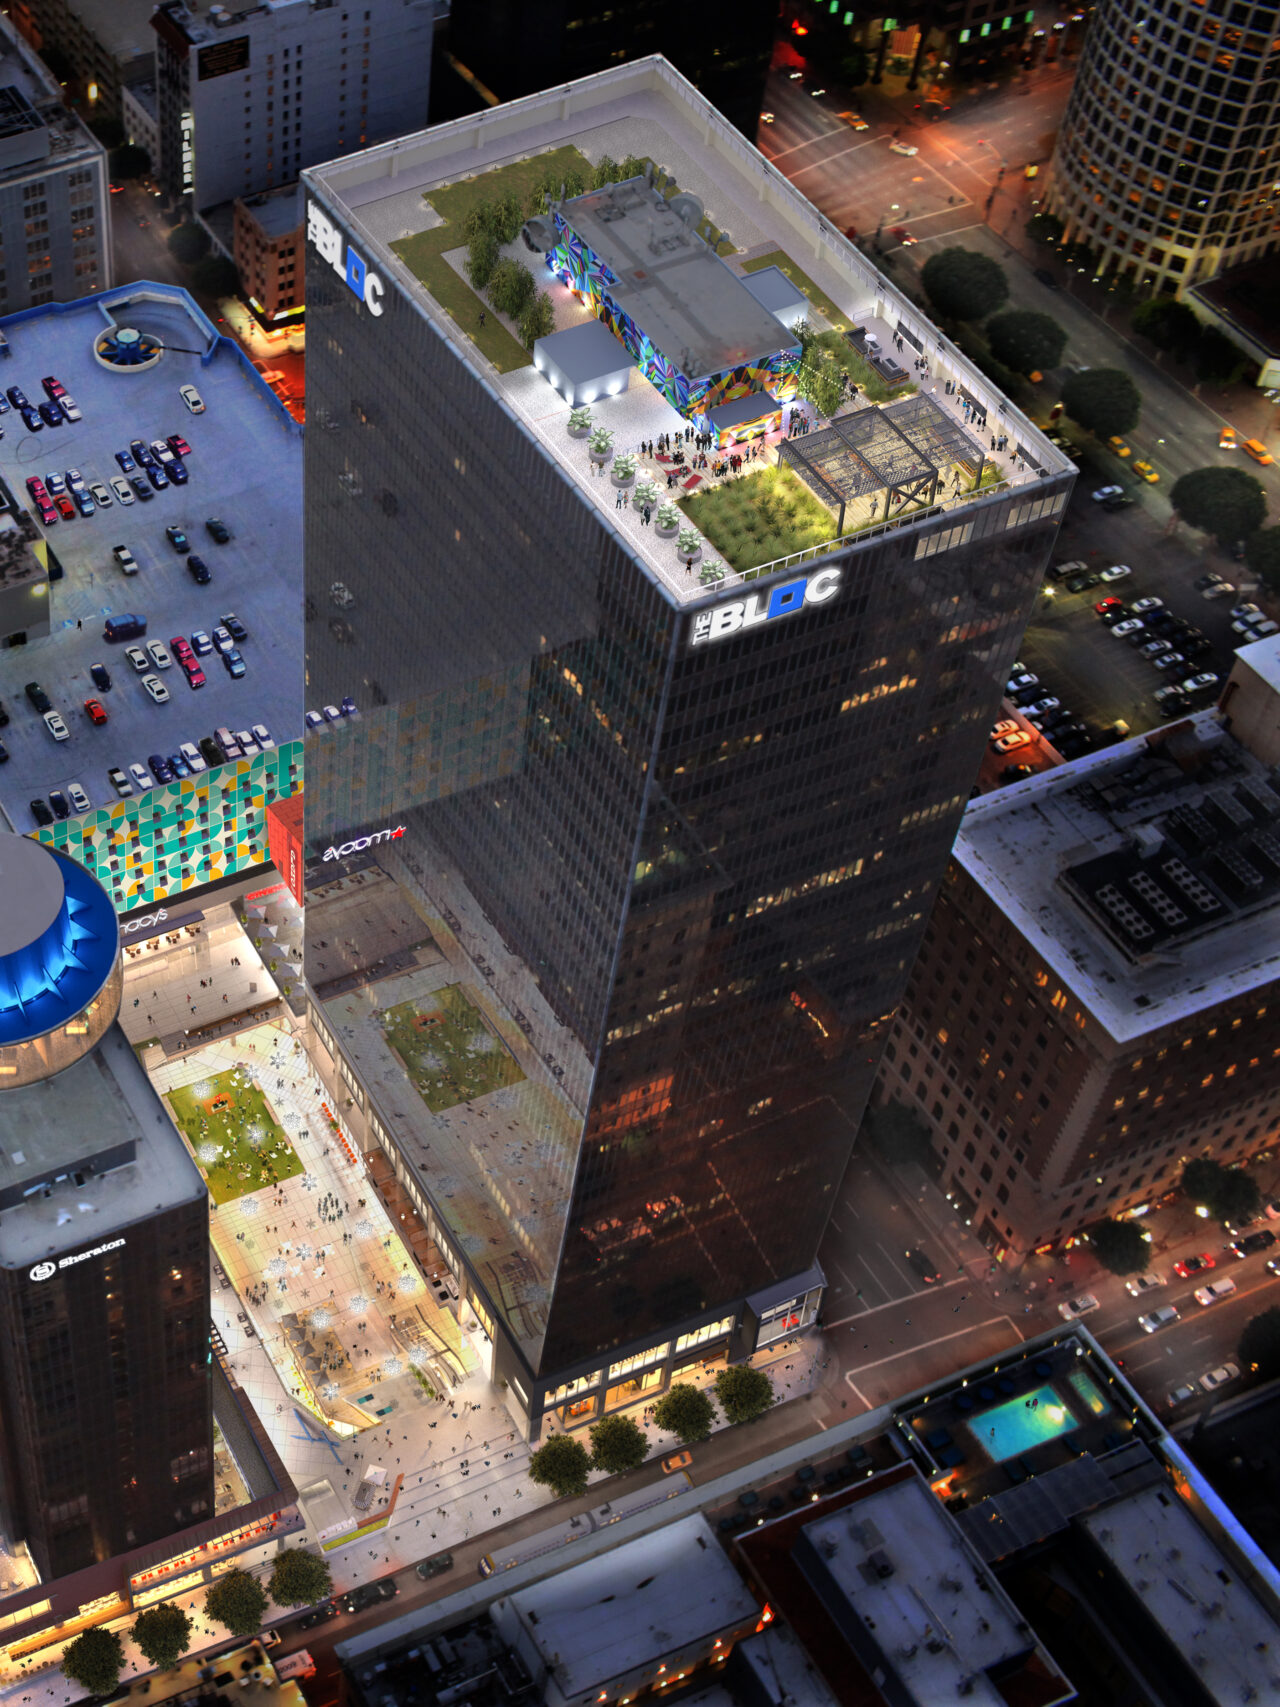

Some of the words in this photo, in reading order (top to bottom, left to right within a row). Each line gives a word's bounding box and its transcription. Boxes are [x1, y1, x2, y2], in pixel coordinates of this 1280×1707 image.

[316, 206, 384, 317] BLOC
[692, 611, 713, 645] THE
[708, 569, 841, 640] BLOC
[58, 1238, 126, 1269] Sheraton
